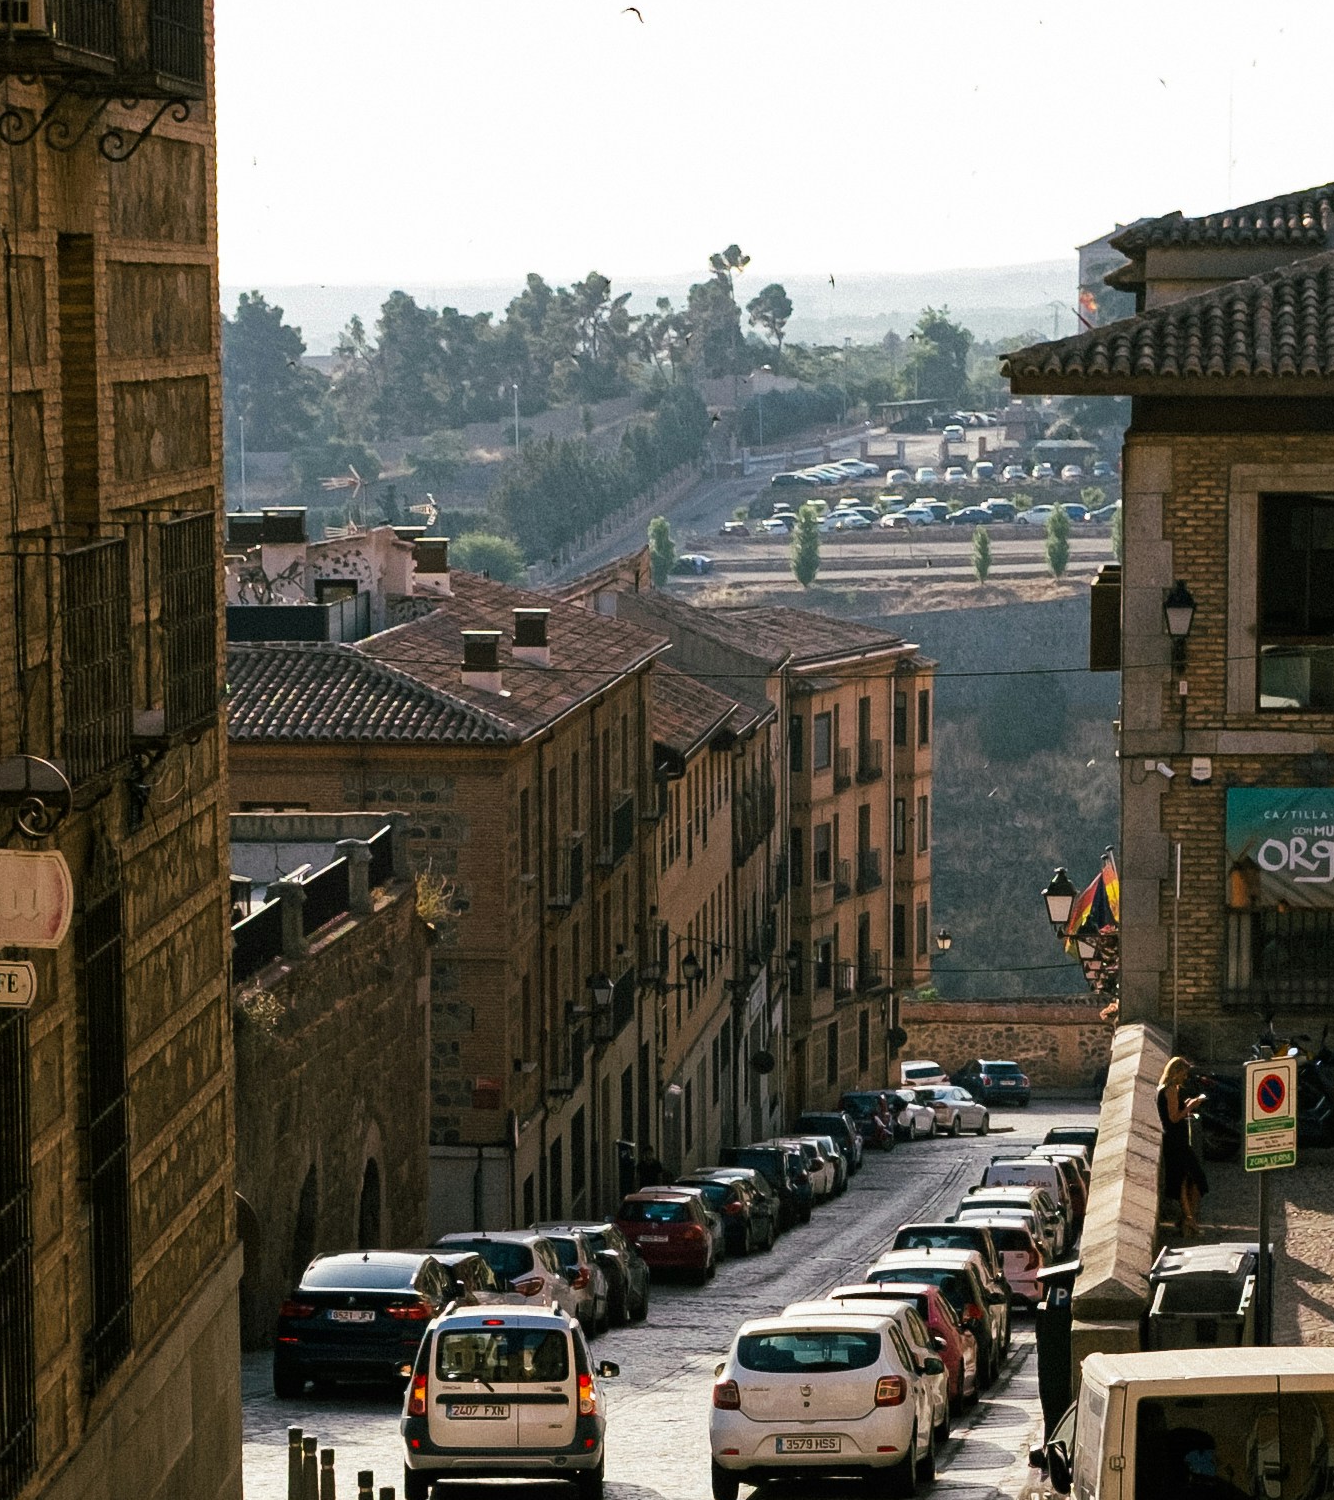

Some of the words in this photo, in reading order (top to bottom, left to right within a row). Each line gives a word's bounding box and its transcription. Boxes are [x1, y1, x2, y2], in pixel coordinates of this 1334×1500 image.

[1055, 1287, 1068, 1306] P
[452, 1406, 479, 1416] 2407
[484, 1406, 505, 1416] FXN
[786, 1439, 813, 1450] 3579
